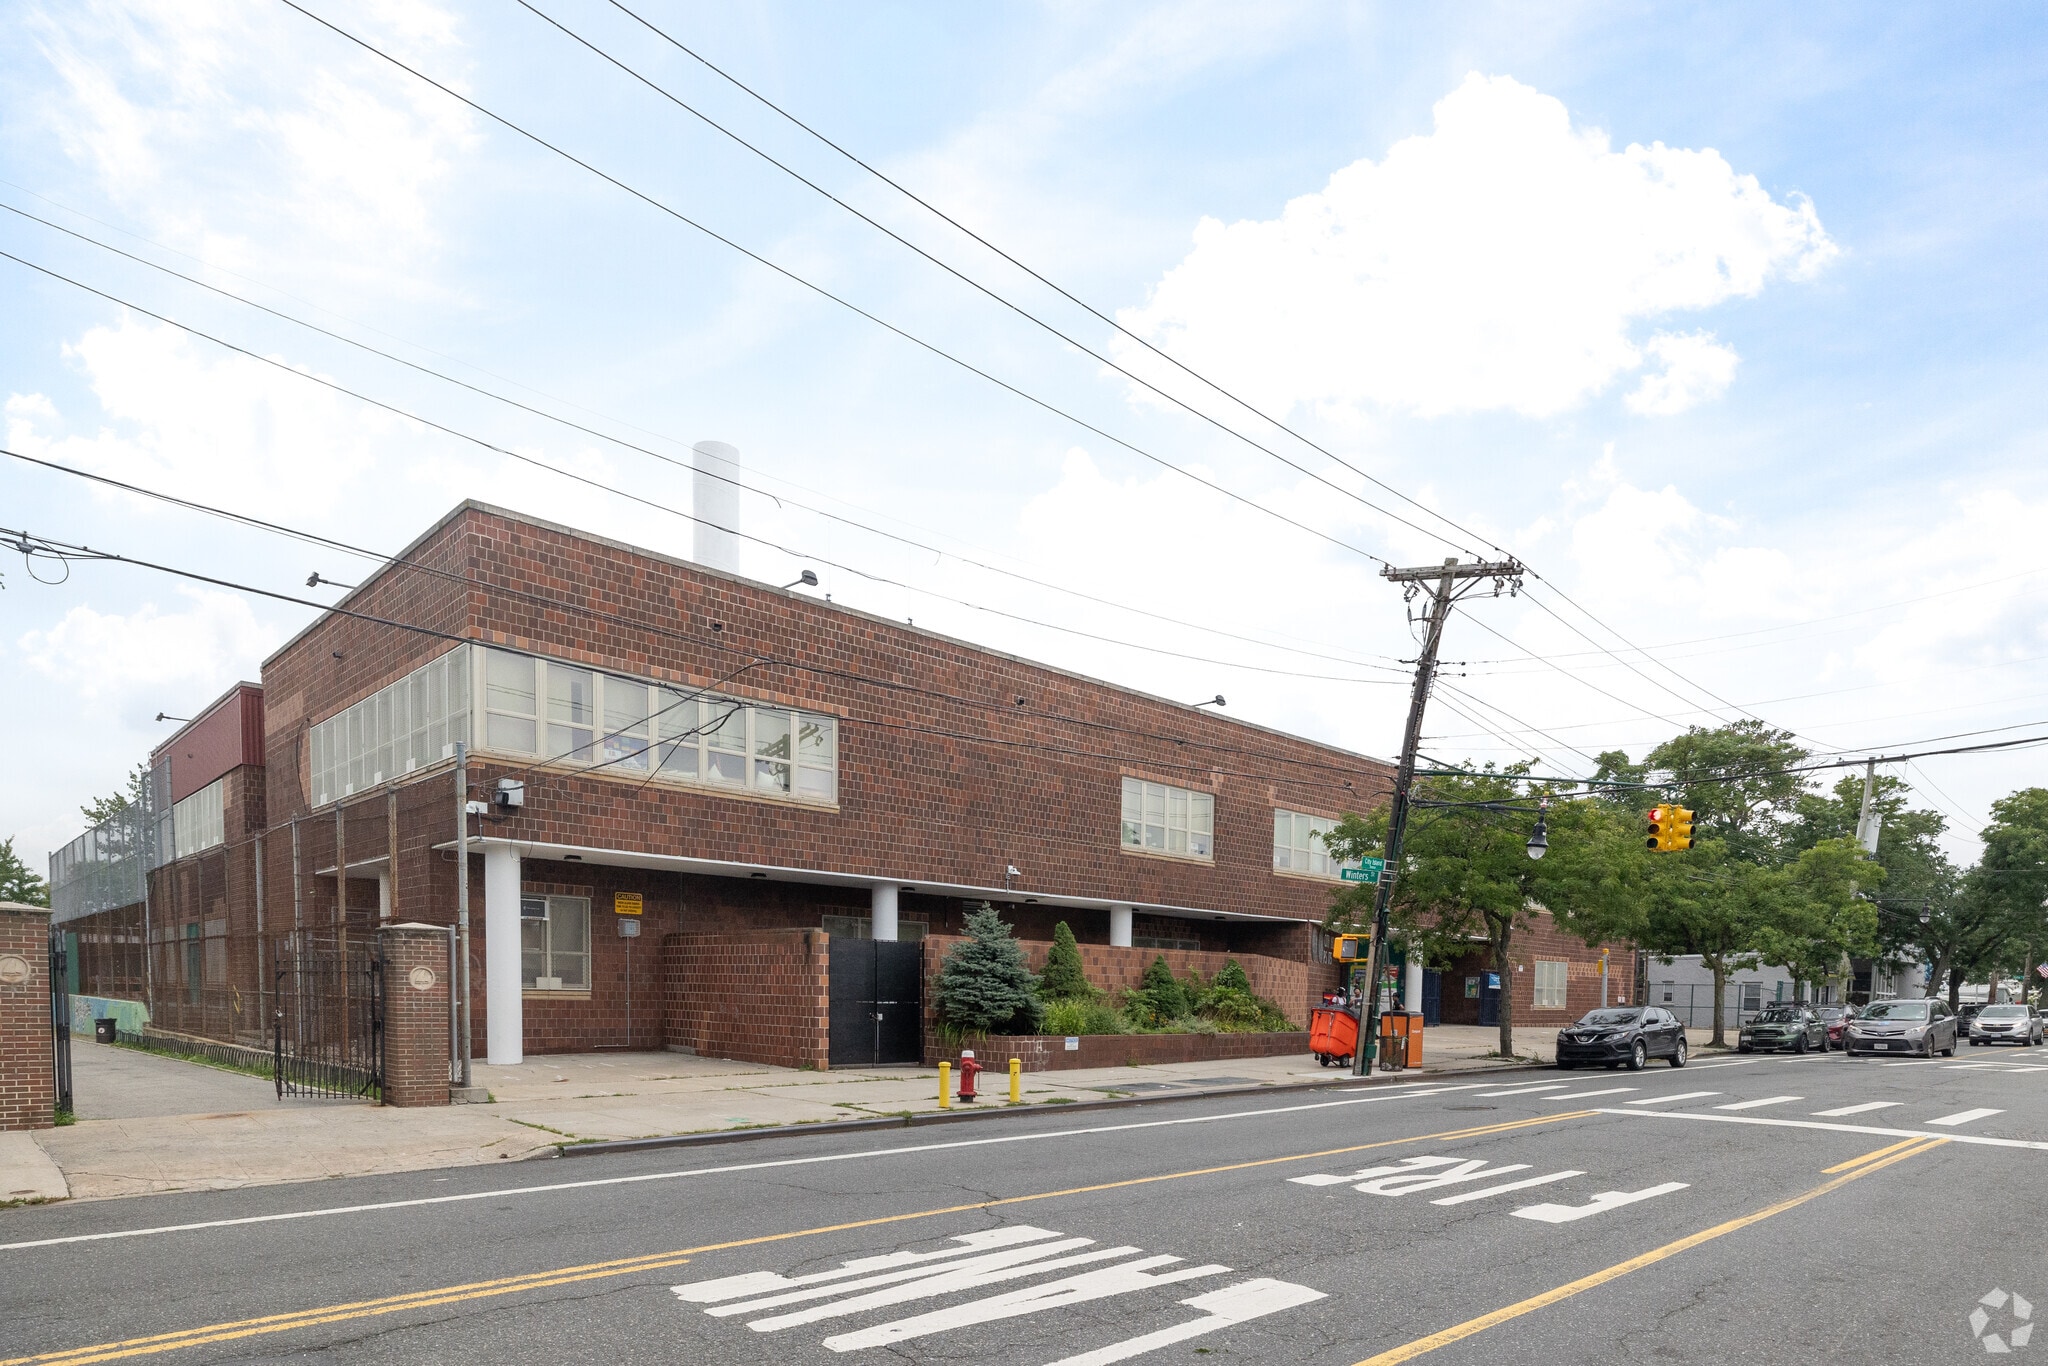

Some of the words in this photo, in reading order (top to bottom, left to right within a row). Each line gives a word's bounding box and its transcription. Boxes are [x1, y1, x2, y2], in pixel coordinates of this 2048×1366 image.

[1346, 870, 1369, 881] Winters
[616, 893, 641, 901] CAUTION
[1286, 1155, 1691, 1224] FIRE
